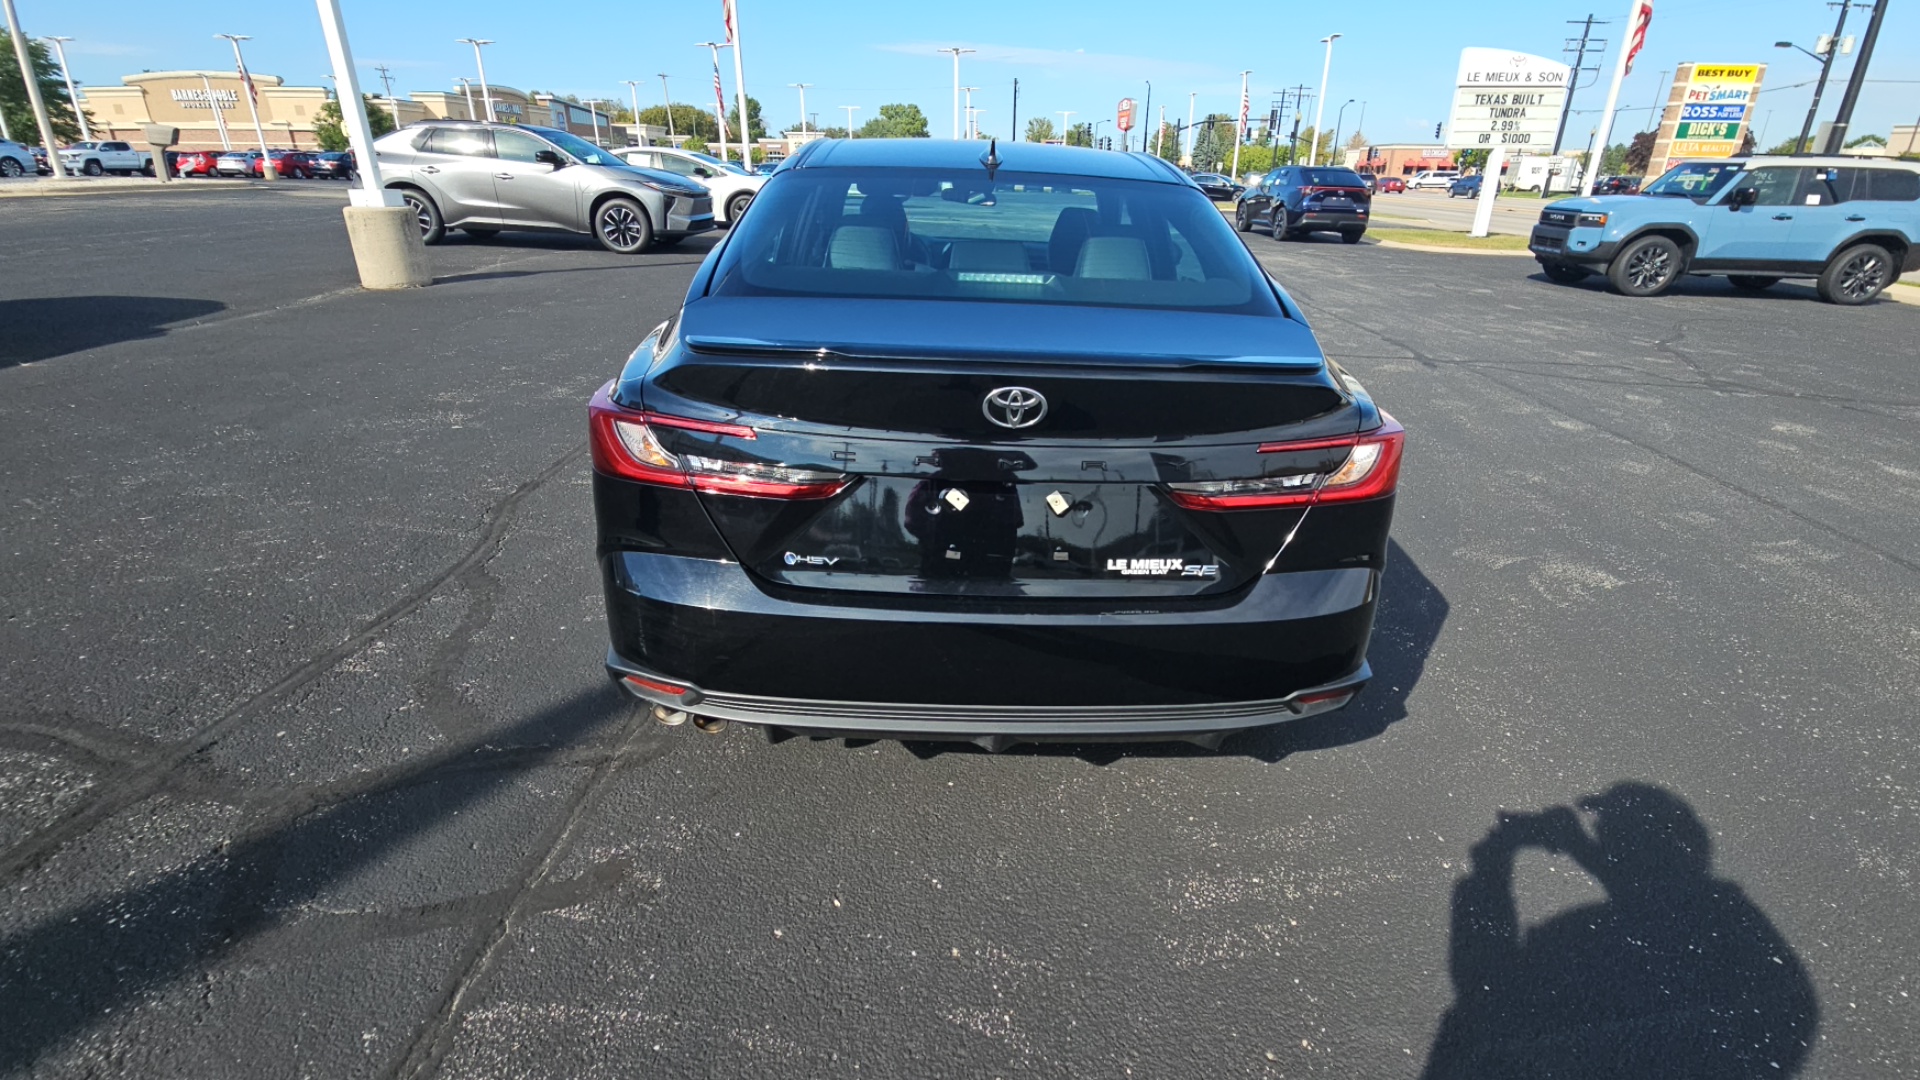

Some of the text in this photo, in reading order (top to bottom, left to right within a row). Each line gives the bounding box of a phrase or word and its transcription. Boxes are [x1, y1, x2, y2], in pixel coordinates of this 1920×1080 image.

[1467, 72, 1563, 82] LE MIEUX & SON
[1697, 69, 1752, 77] BEST BUY
[170, 89, 203, 101] BARNES
[1475, 94, 1544, 105] TEXAS BUILT
[1490, 107, 1526, 118] TUNDRA
[1682, 106, 1718, 118] ROSS
[1491, 120, 1521, 131] 2.99%
[1688, 123, 1728, 135] DICK'S
[1478, 133, 1491, 144] OR
[1675, 142, 1732, 152] ULTA BEAUTY
[1107, 559, 1182, 570] LE MIEUX
[1181, 565, 1219, 576] SE
